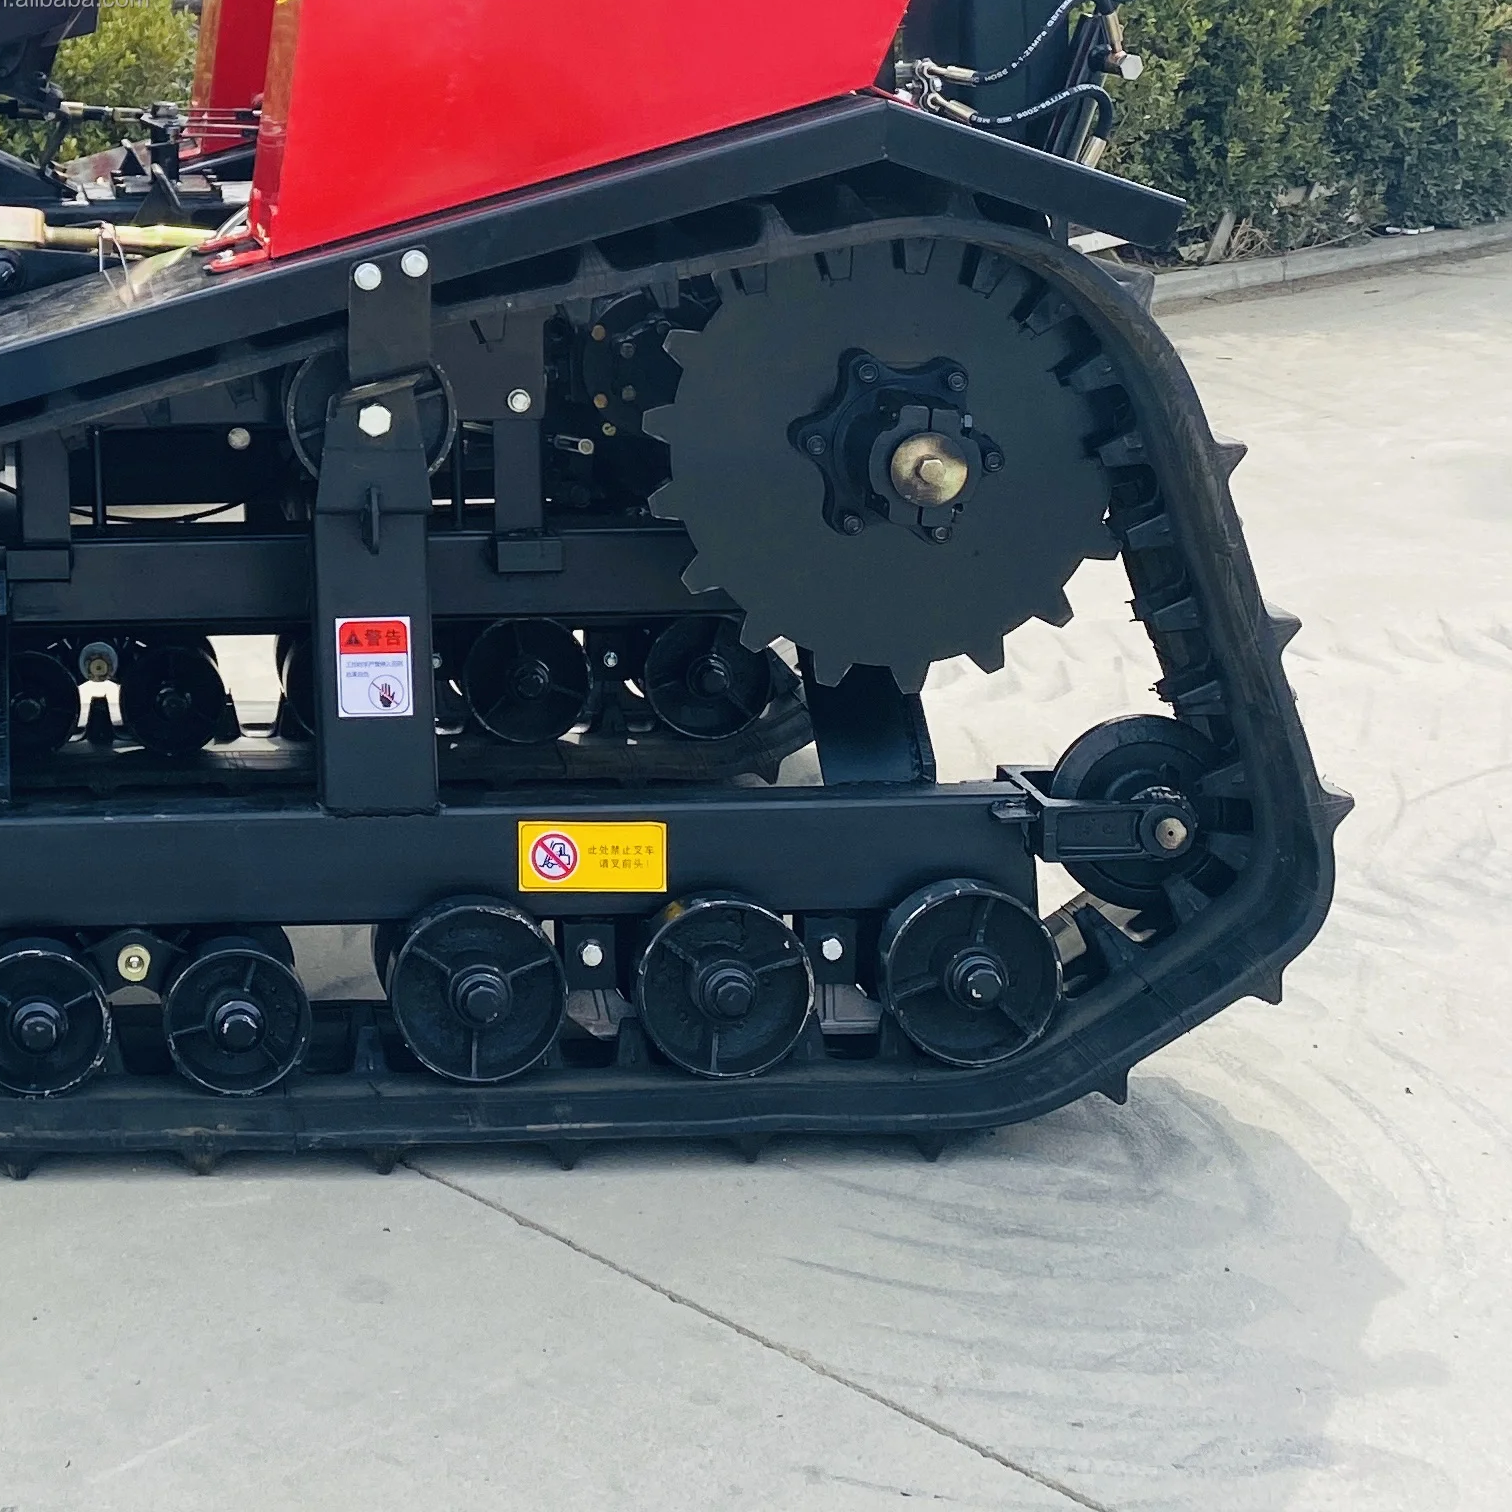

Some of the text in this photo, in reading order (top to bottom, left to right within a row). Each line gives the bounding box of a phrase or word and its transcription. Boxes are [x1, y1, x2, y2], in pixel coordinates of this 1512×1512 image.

[365, 629, 402, 646] 警告
[587, 844, 655, 856] 此处禁止叉车
